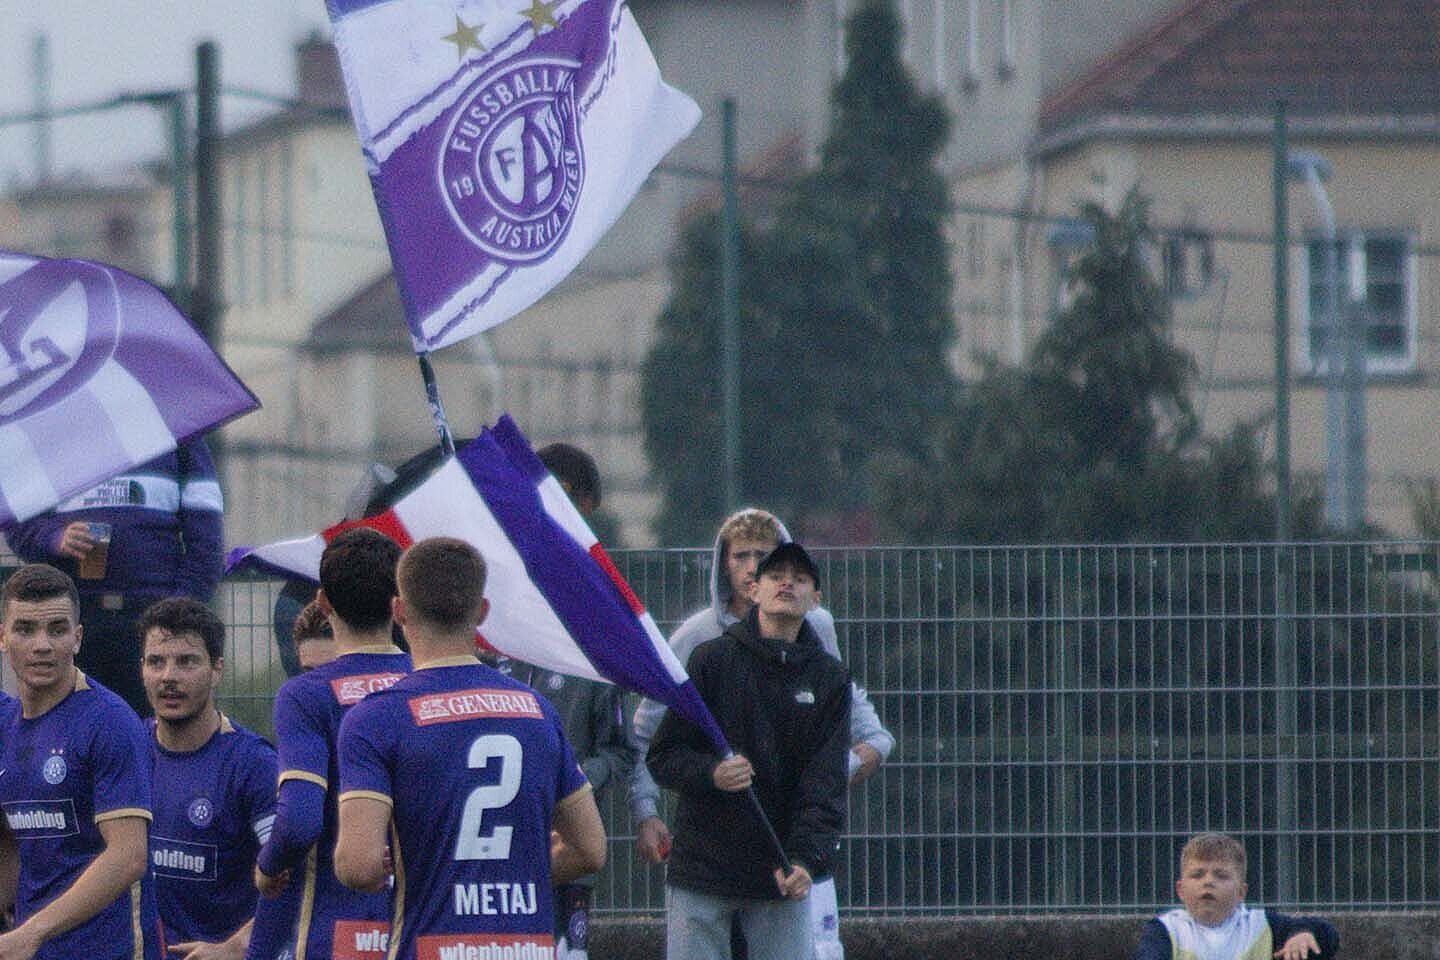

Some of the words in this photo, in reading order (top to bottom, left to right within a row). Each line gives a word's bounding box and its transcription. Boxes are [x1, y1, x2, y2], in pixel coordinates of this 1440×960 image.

[452, 176, 475, 199] 19
[480, 212, 561, 249] AUSTRIA
[454, 734, 523, 860] 2
[455, 882, 538, 915] METAJ
